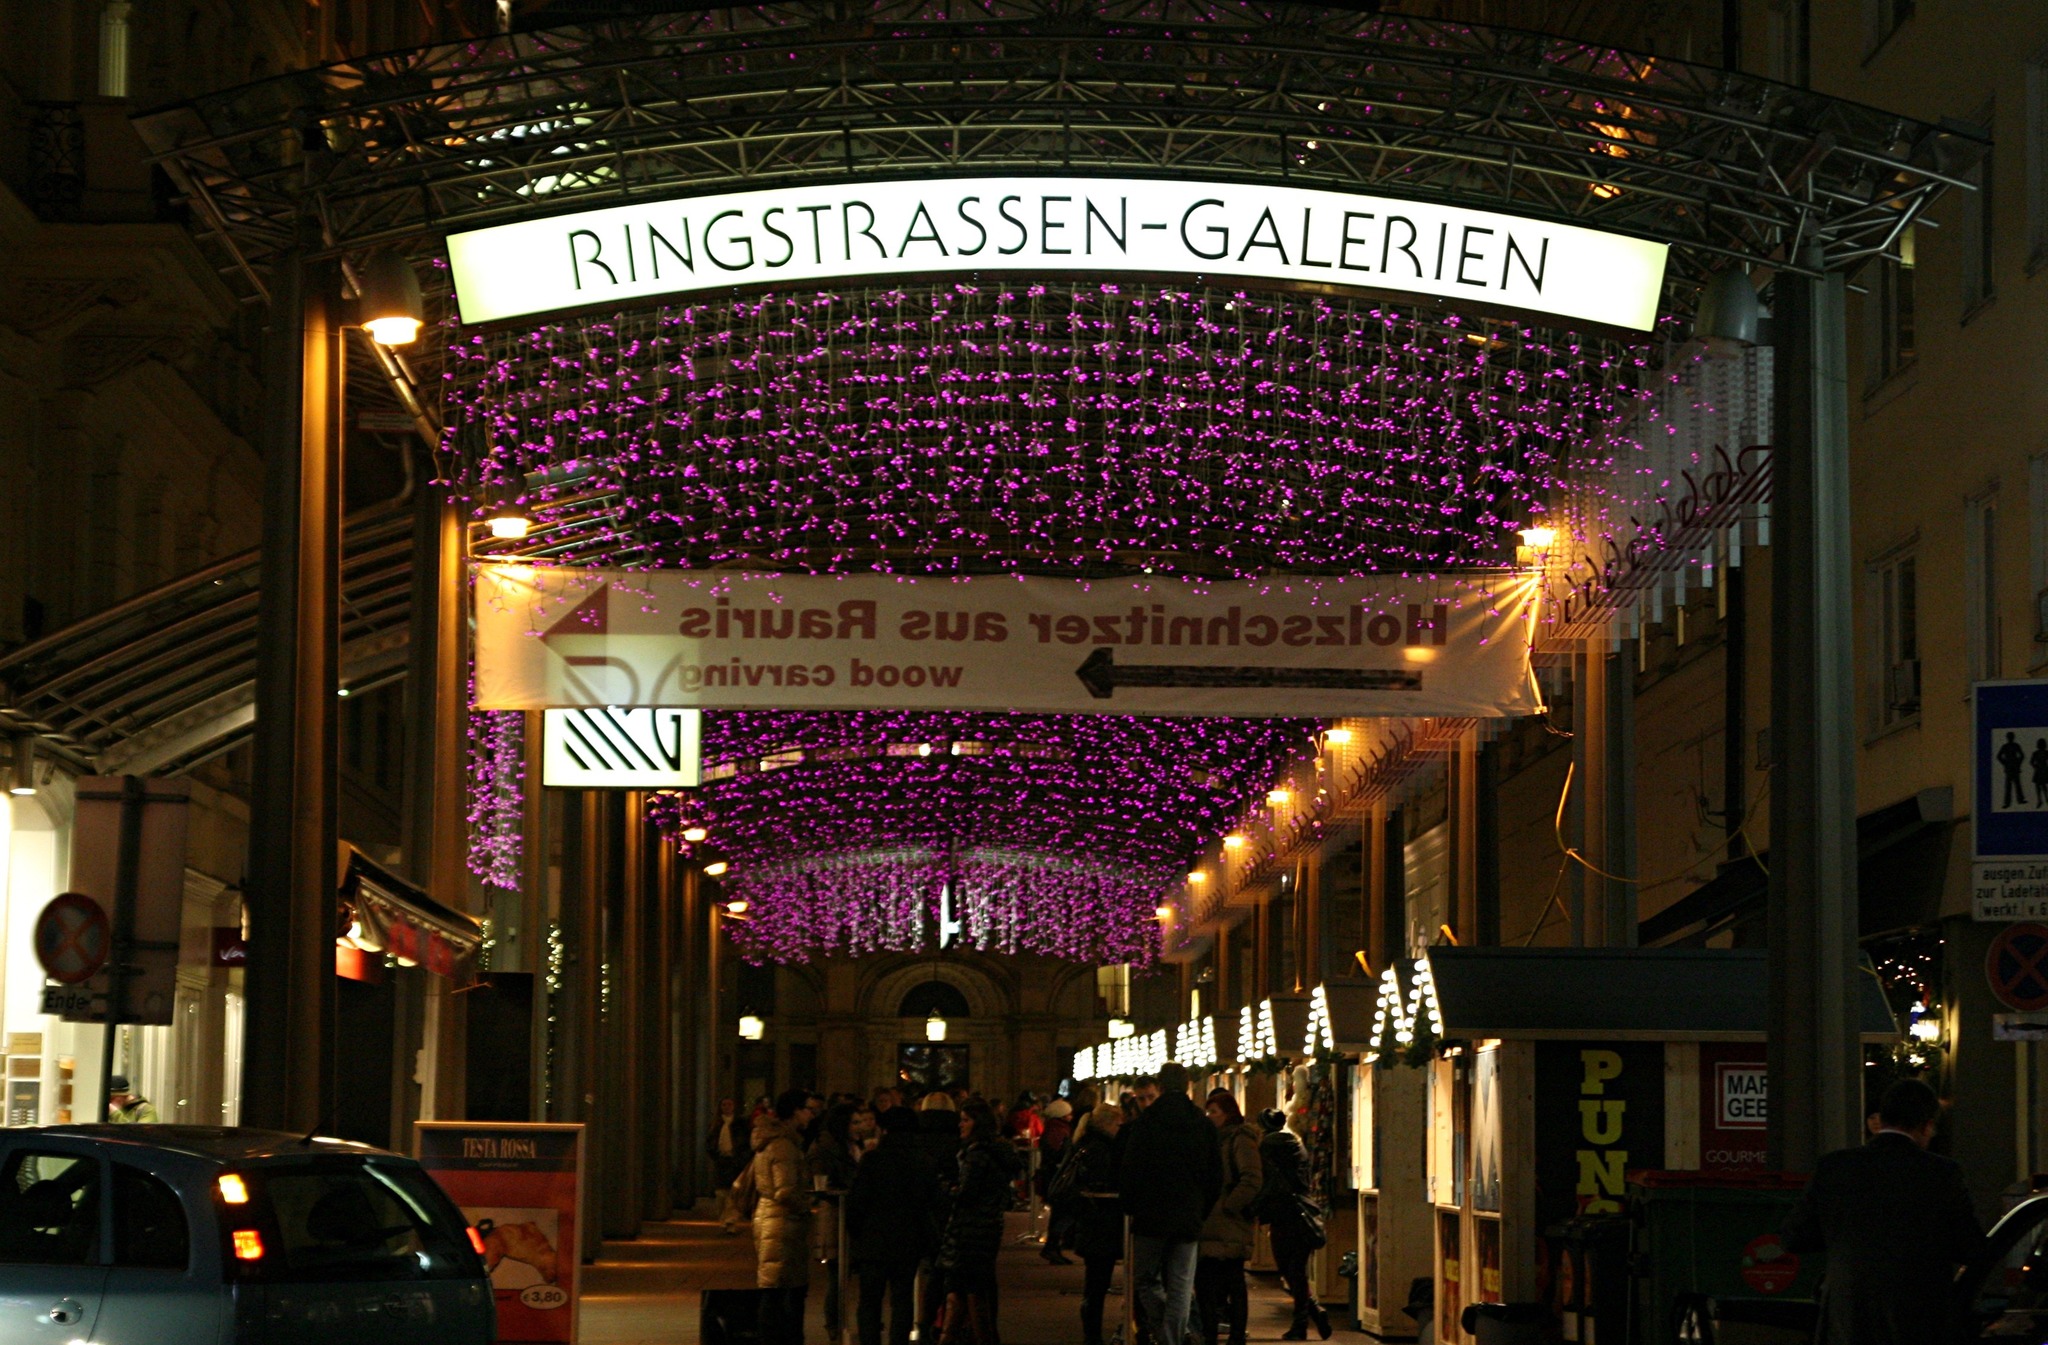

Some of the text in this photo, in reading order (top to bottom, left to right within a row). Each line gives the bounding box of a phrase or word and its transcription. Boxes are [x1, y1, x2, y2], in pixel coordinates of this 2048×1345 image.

[569, 196, 1549, 295] RINGSTRASSEN-GALERIEN
[1977, 888, 1997, 898] zur
[46, 990, 87, 1010] Ende
[463, 1137, 537, 1158] TESTA ROSSA
